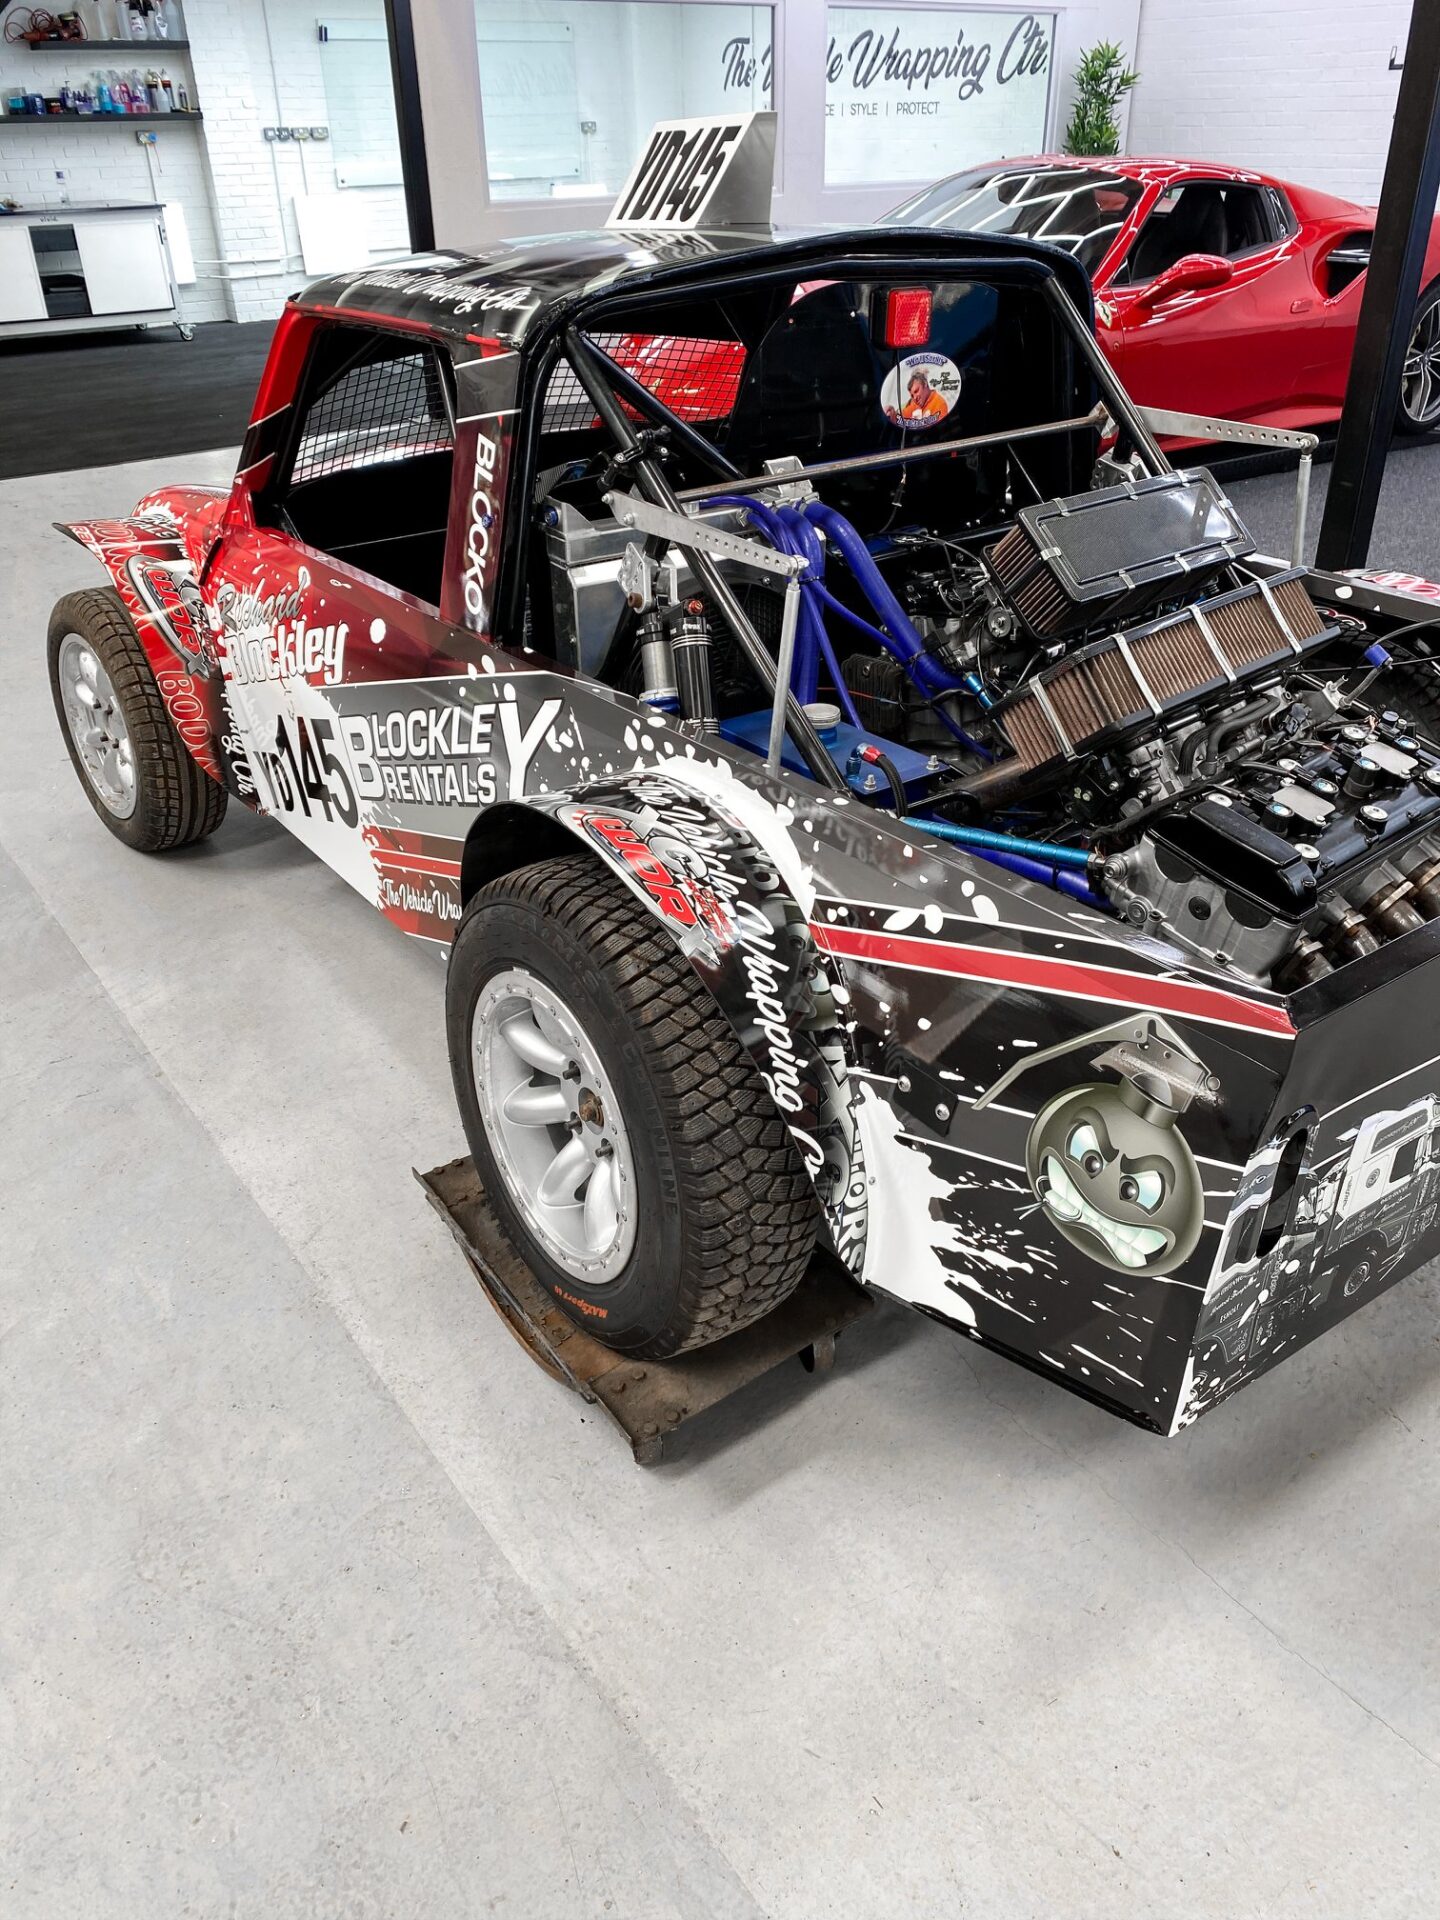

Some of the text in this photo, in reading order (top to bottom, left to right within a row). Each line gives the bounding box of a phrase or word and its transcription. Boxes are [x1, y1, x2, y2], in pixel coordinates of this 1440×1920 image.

[722, 37, 757, 92] The
[848, 26, 991, 100] Wrapping
[996, 15, 1048, 84] Ctr.
[850, 102, 878, 116] STYLE
[896, 101, 940, 116] PROTECT
[616, 125, 743, 222] YD145
[464, 432, 496, 616] BLOCKO
[216, 570, 307, 632] Richard
[224, 619, 350, 686] Blockley
[338, 698, 565, 803] BLOCKLEY
[380, 761, 499, 808] RENTALS
[383, 878, 401, 907] The
[399, 883, 434, 914] Vehicle
[587, 817, 724, 967] WORX
